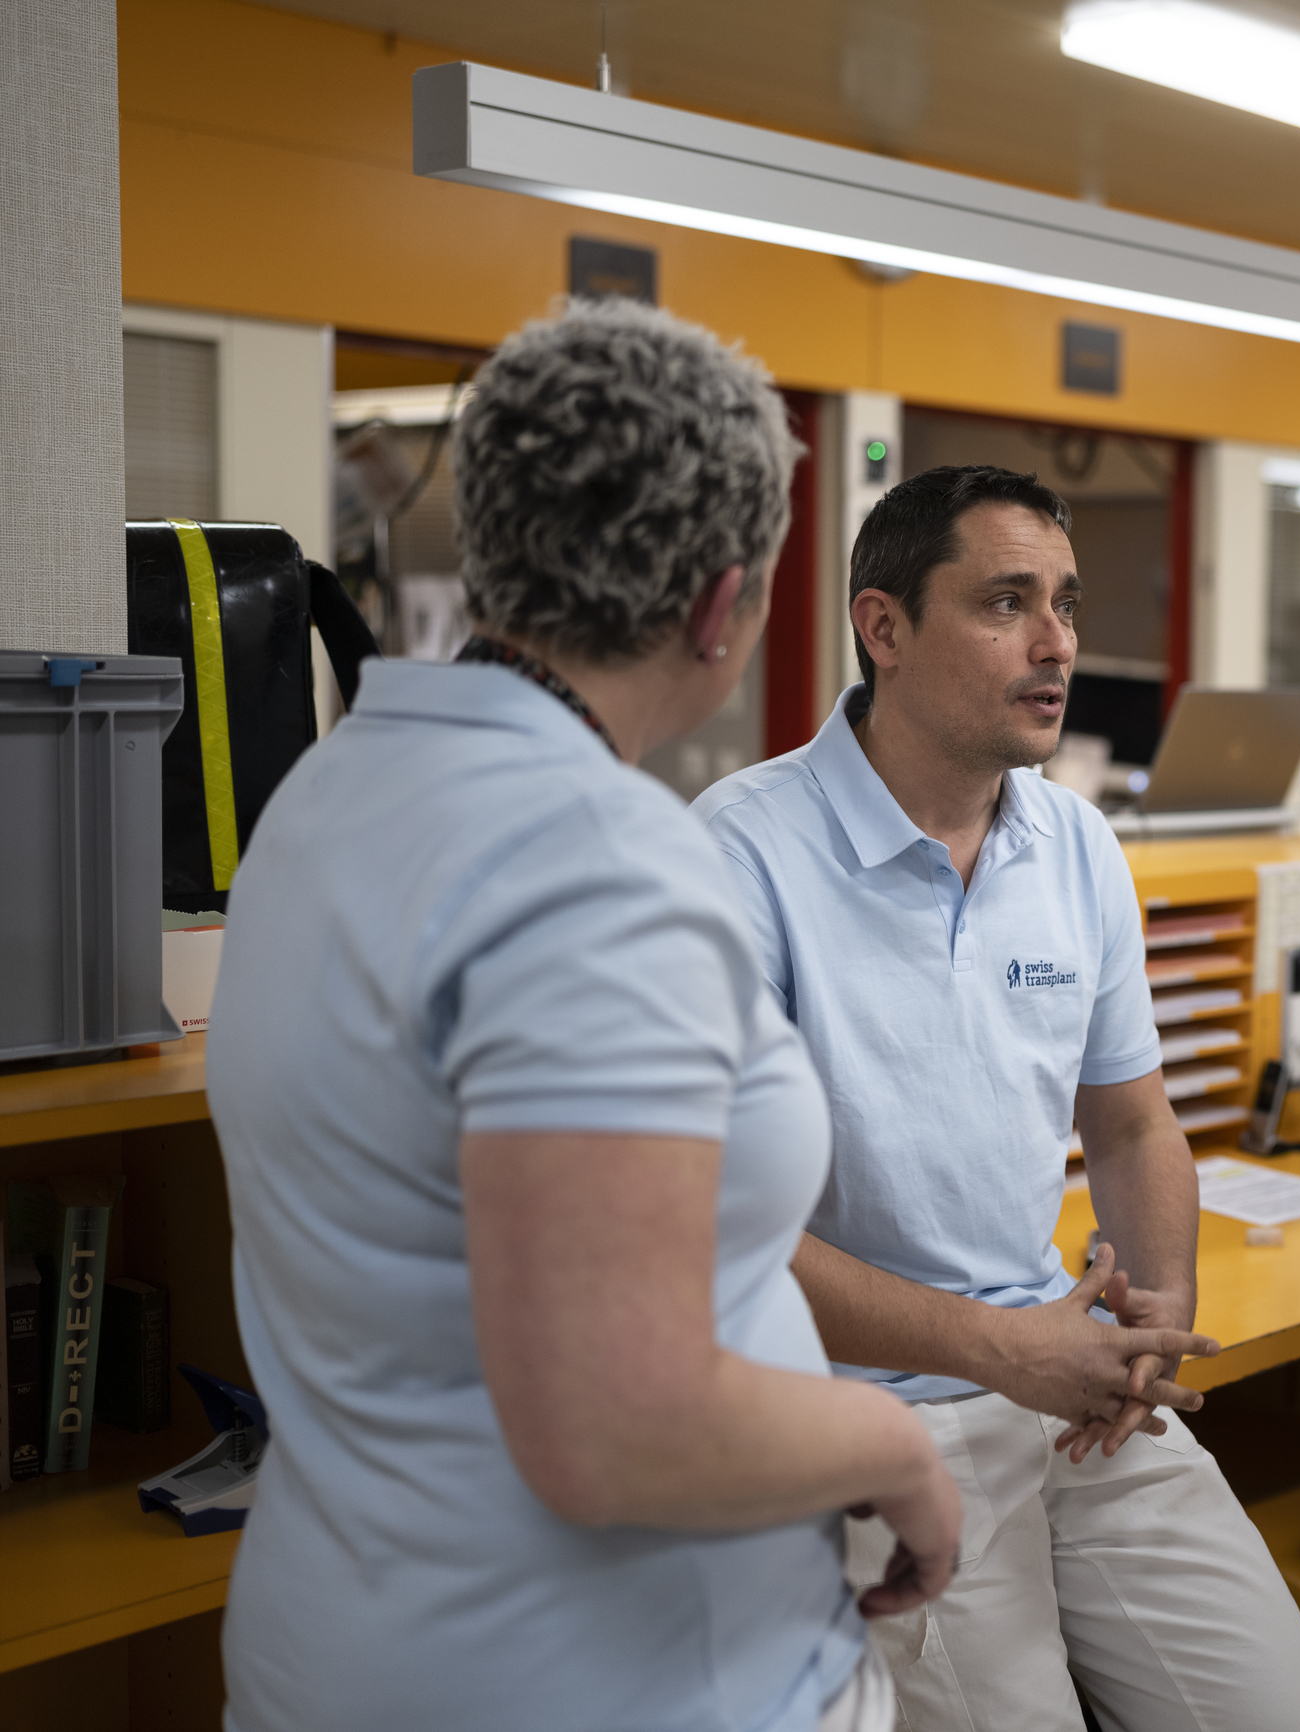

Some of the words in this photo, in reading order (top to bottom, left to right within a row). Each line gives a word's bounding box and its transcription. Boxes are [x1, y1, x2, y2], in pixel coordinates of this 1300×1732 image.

[1024, 960, 1053, 974] swiss
[1025, 971, 1077, 988] transplant
[13, 1316, 34, 1326] HOLY
[13, 1323, 34, 1333] BIBLE
[17, 1386, 31, 1395] NIV
